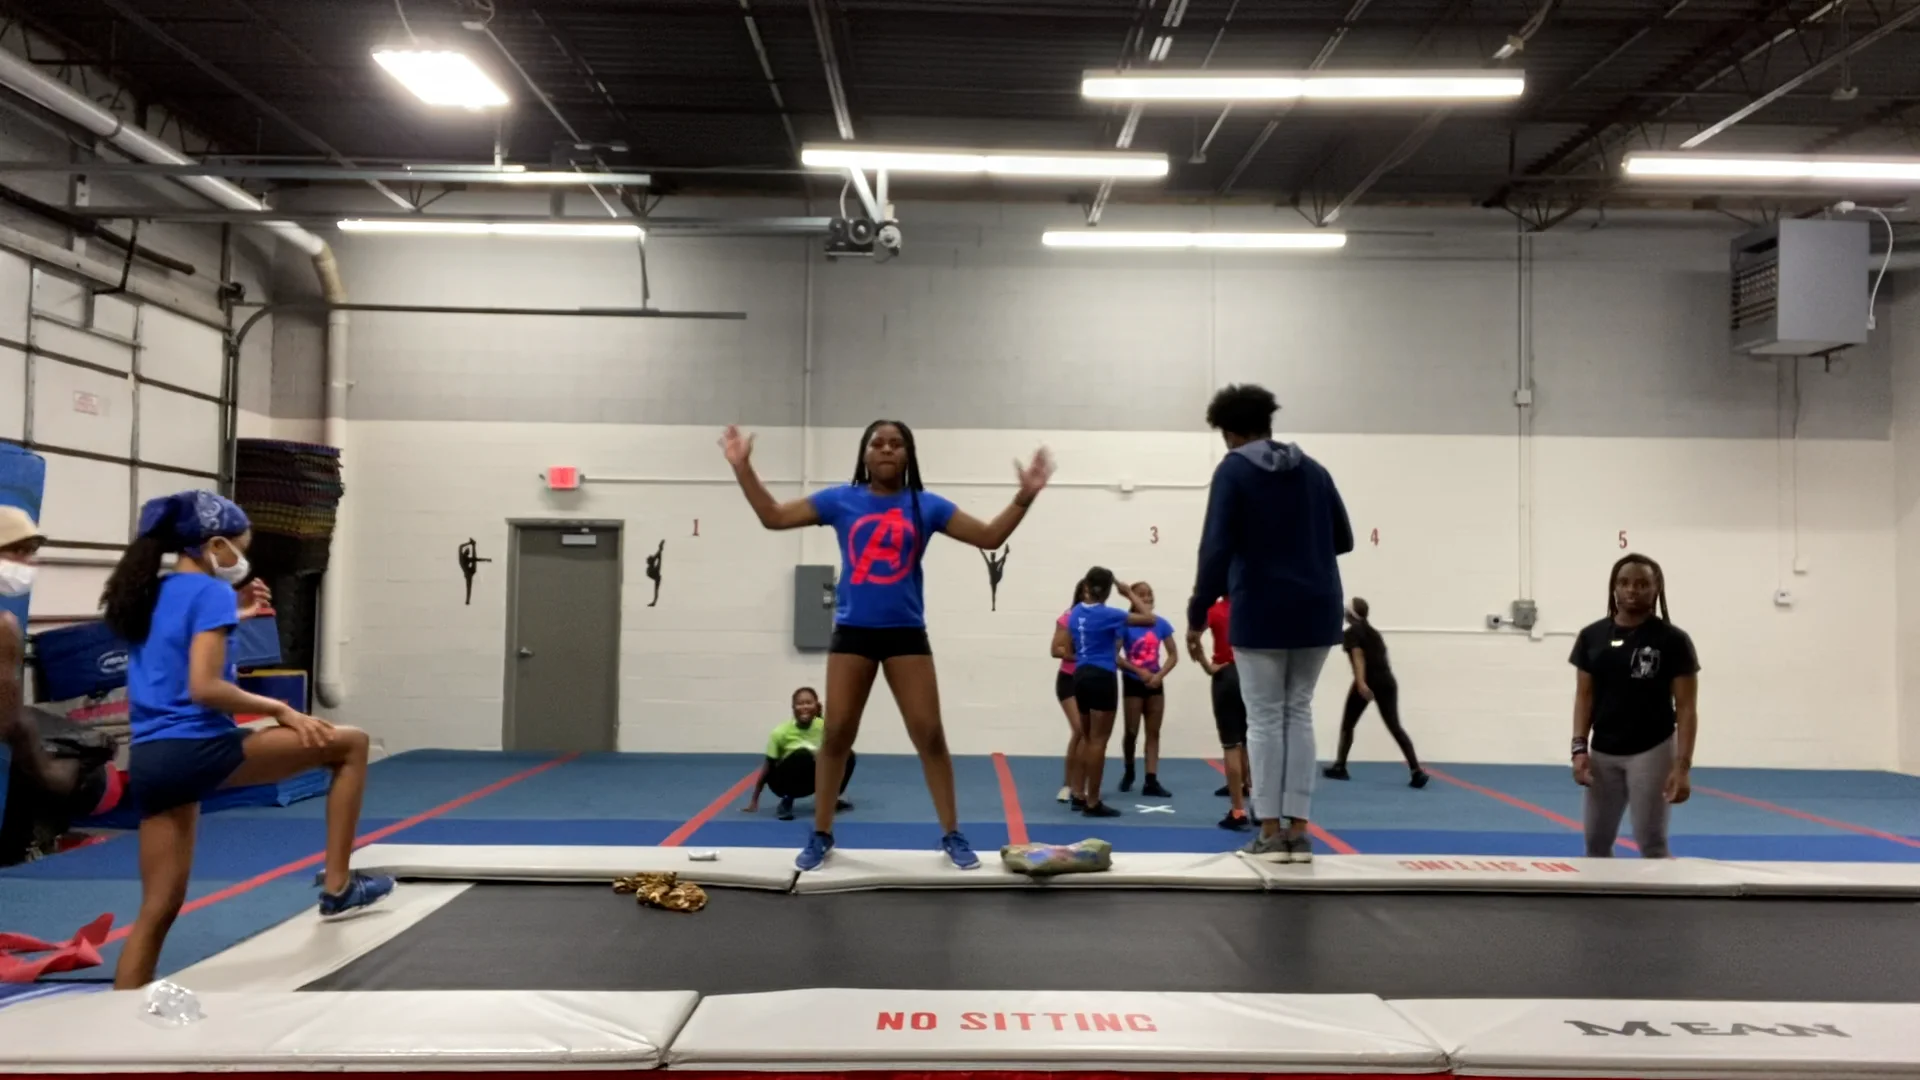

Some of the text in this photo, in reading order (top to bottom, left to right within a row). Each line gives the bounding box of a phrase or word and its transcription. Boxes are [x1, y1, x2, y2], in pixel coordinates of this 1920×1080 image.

[692, 518, 700, 537] 1
[1149, 525, 1159, 544] 3
[1369, 527, 1380, 546] 4
[849, 507, 905, 585] A
[1618, 530, 1628, 549] 5
[876, 1011, 1158, 1032] NO SITTING
[1563, 1020, 1853, 1038] MEAN
